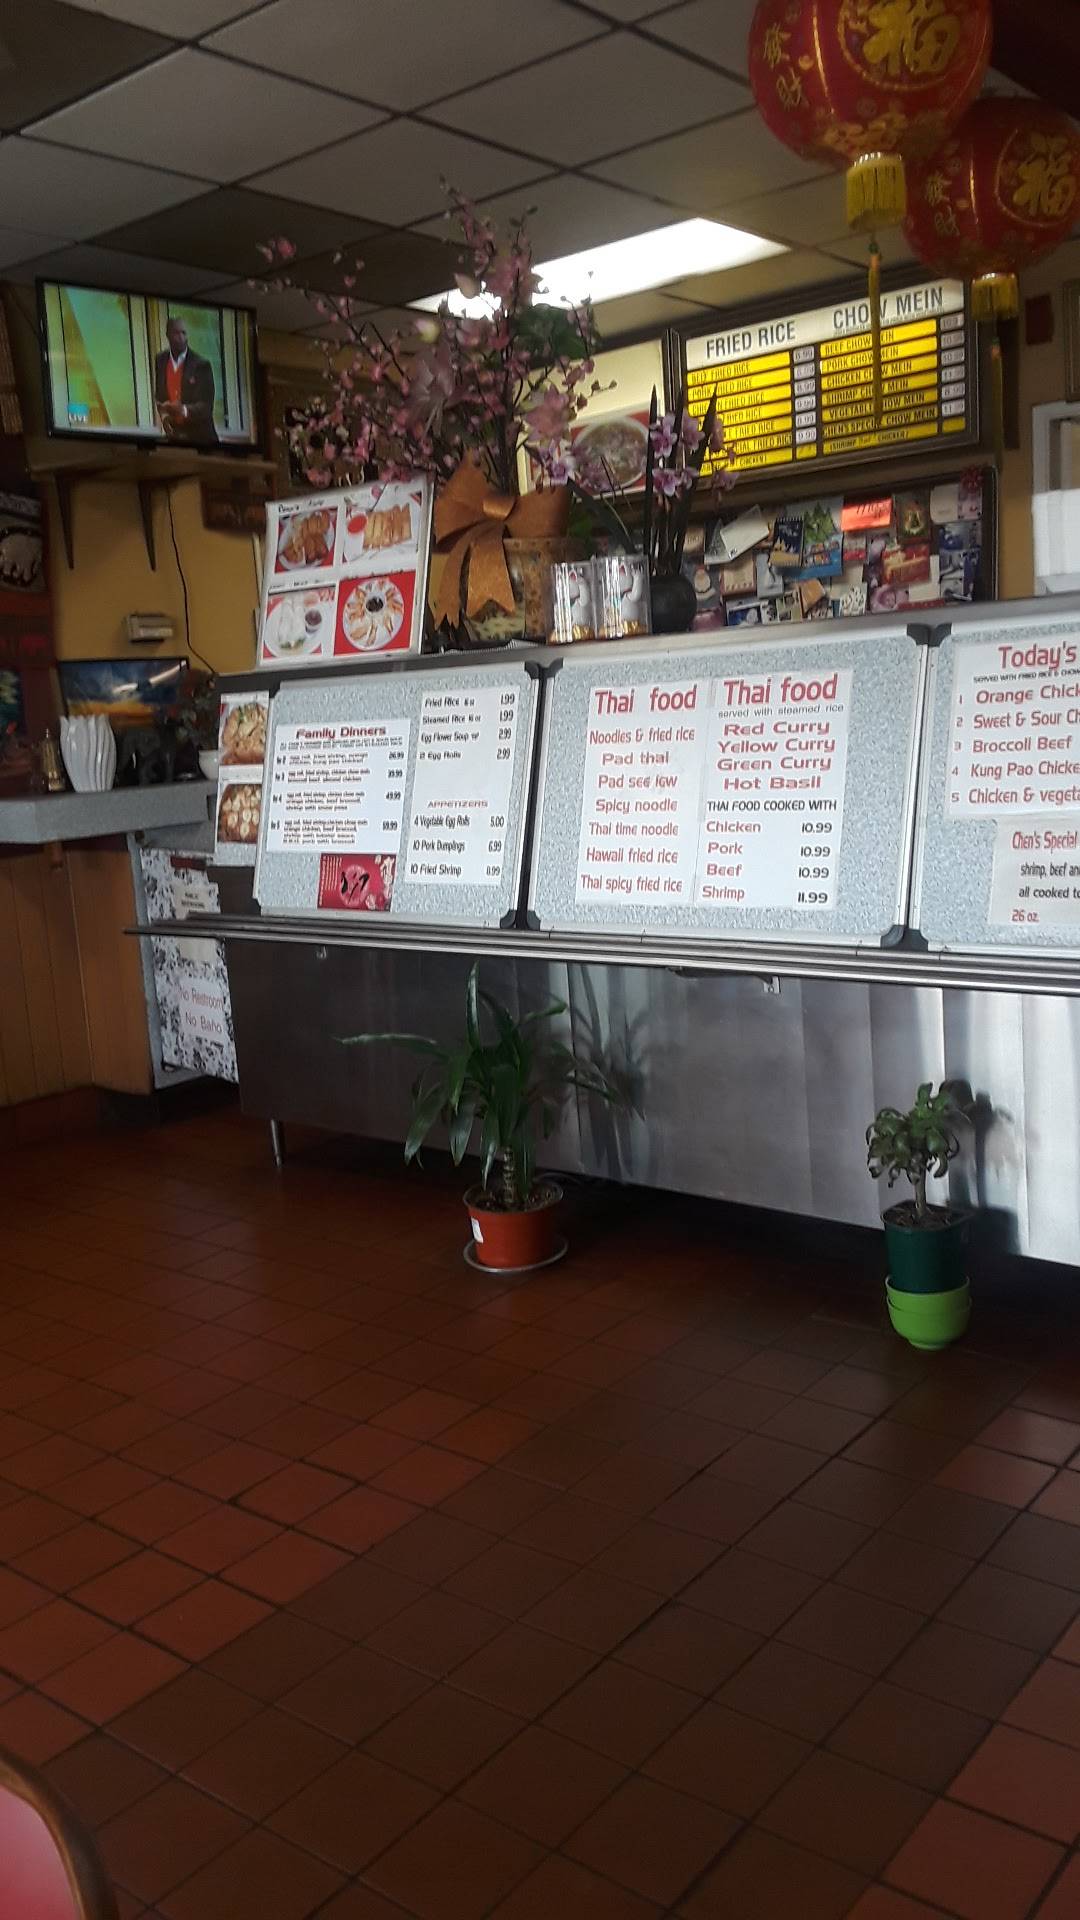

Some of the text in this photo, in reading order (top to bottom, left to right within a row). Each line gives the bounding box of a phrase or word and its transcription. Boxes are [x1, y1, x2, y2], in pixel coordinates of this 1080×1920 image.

[896, 287, 943, 316] MEIN
[706, 320, 796, 359] FRIED RICE
[891, 362, 912, 374] MEIN
[998, 640, 1077, 670] Today's
[723, 672, 838, 706] Thai food
[424, 698, 442, 708] Fried
[444, 697, 460, 707] Rice
[595, 683, 698, 715] Thai food
[976, 689, 1034, 705] Orange
[718, 703, 844, 718] served with steamed rice
[423, 715, 450, 725] Steamed
[451, 714, 465, 724] Rice
[973, 713, 1011, 729] Sweet
[1015, 712, 1026, 727] &
[1031, 710, 1062, 726] Sour
[296, 725, 386, 740] Family Dinners
[589, 726, 695, 745] Noodles & fried rice
[723, 721, 830, 736] Red Curry
[421, 733, 432, 744] Egg
[454, 731, 469, 742] Soup
[972, 737, 1032, 753] Broccoli
[1037, 735, 1073, 750] Beef
[717, 738, 836, 753] Yellow Curry
[427, 752, 442, 760] Egg
[443, 751, 461, 759] Rolls
[602, 751, 670, 765] Pad thai
[717, 756, 832, 771] Green Curry
[951, 766, 959, 776] 4
[971, 763, 1002, 780] Kung
[1007, 762, 1034, 776] Pao
[598, 774, 625, 788] Pad
[628, 775, 651, 788] see
[723, 776, 821, 790] Hot Basil
[951, 792, 960, 802] 5
[968, 788, 1018, 804] Chicken
[1023, 787, 1034, 802] &
[595, 798, 678, 815] Spicy noodle
[707, 800, 837, 811] THAI FOOD COOKED WITH
[414, 814, 505, 829] 4 Vegetable Egg Rolls 5.00
[589, 821, 679, 836] Thai time noodle
[706, 821, 833, 833] Chicken 10.99
[413, 840, 502, 853] 10 Pork Dumplings 6.99
[707, 842, 831, 857] Pork 10.99
[1012, 831, 1078, 854] Chen's Special
[586, 847, 679, 863] Hawaii fried rice
[410, 864, 418, 874] 10
[420, 863, 437, 875] Fried
[439, 864, 462, 877] Shrimp
[706, 863, 829, 878] Beef 10.99
[1020, 861, 1068, 879] shrimp, beef
[580, 874, 683, 894] Thai spicy fried rice
[702, 885, 828, 903] Shrimp 11.99
[1019, 886, 1030, 898] all
[1033, 886, 1070, 898] cooked
[1012, 909, 1025, 922] 26
